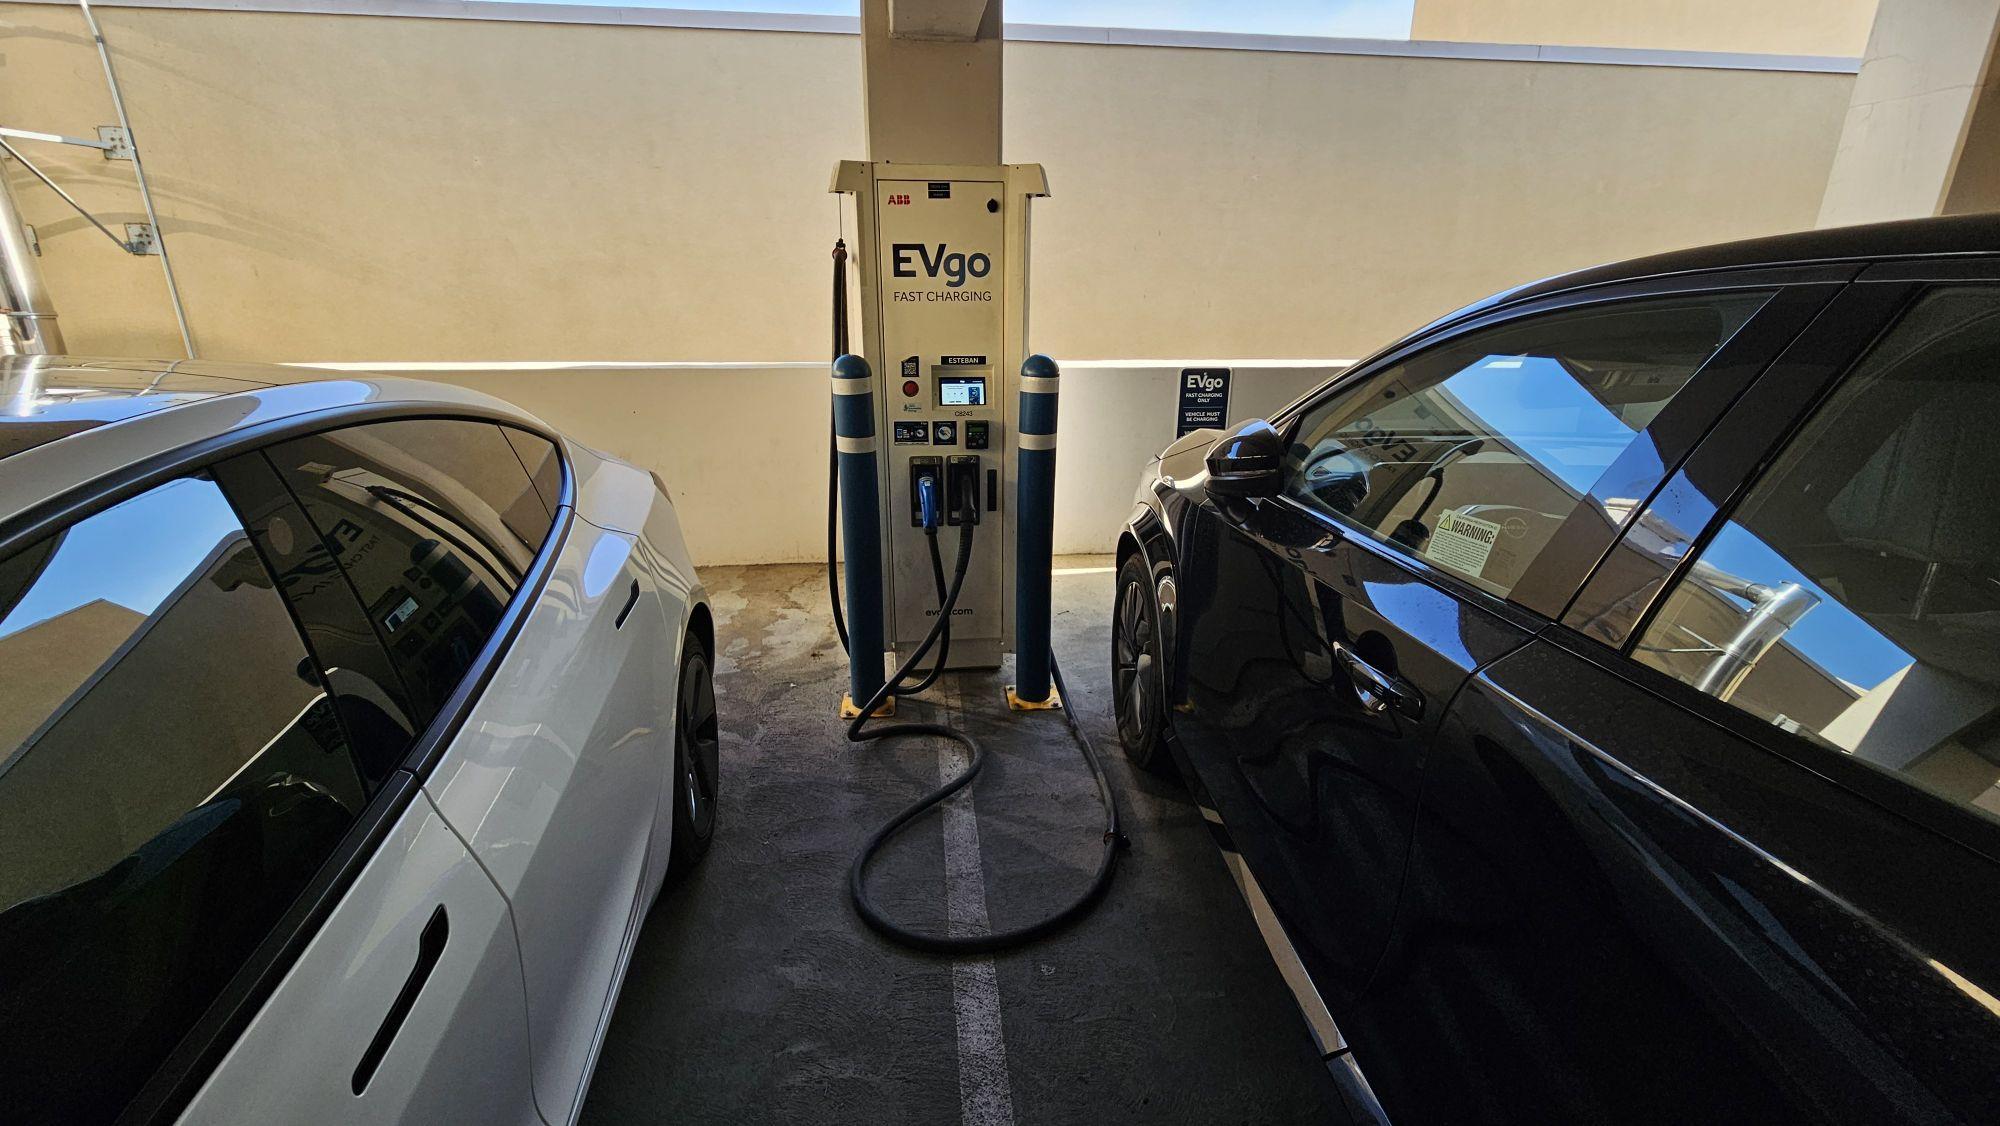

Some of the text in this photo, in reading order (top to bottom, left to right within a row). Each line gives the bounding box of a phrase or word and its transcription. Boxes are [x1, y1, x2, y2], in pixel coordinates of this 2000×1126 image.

[888, 194, 911, 205] ABB
[892, 243, 991, 288] EVgo
[894, 291, 992, 302] FAST CHARGING
[1187, 374, 1224, 391] EVgo
[1451, 519, 1495, 545] WARNING:
[925, 608, 973, 616] ev.com
